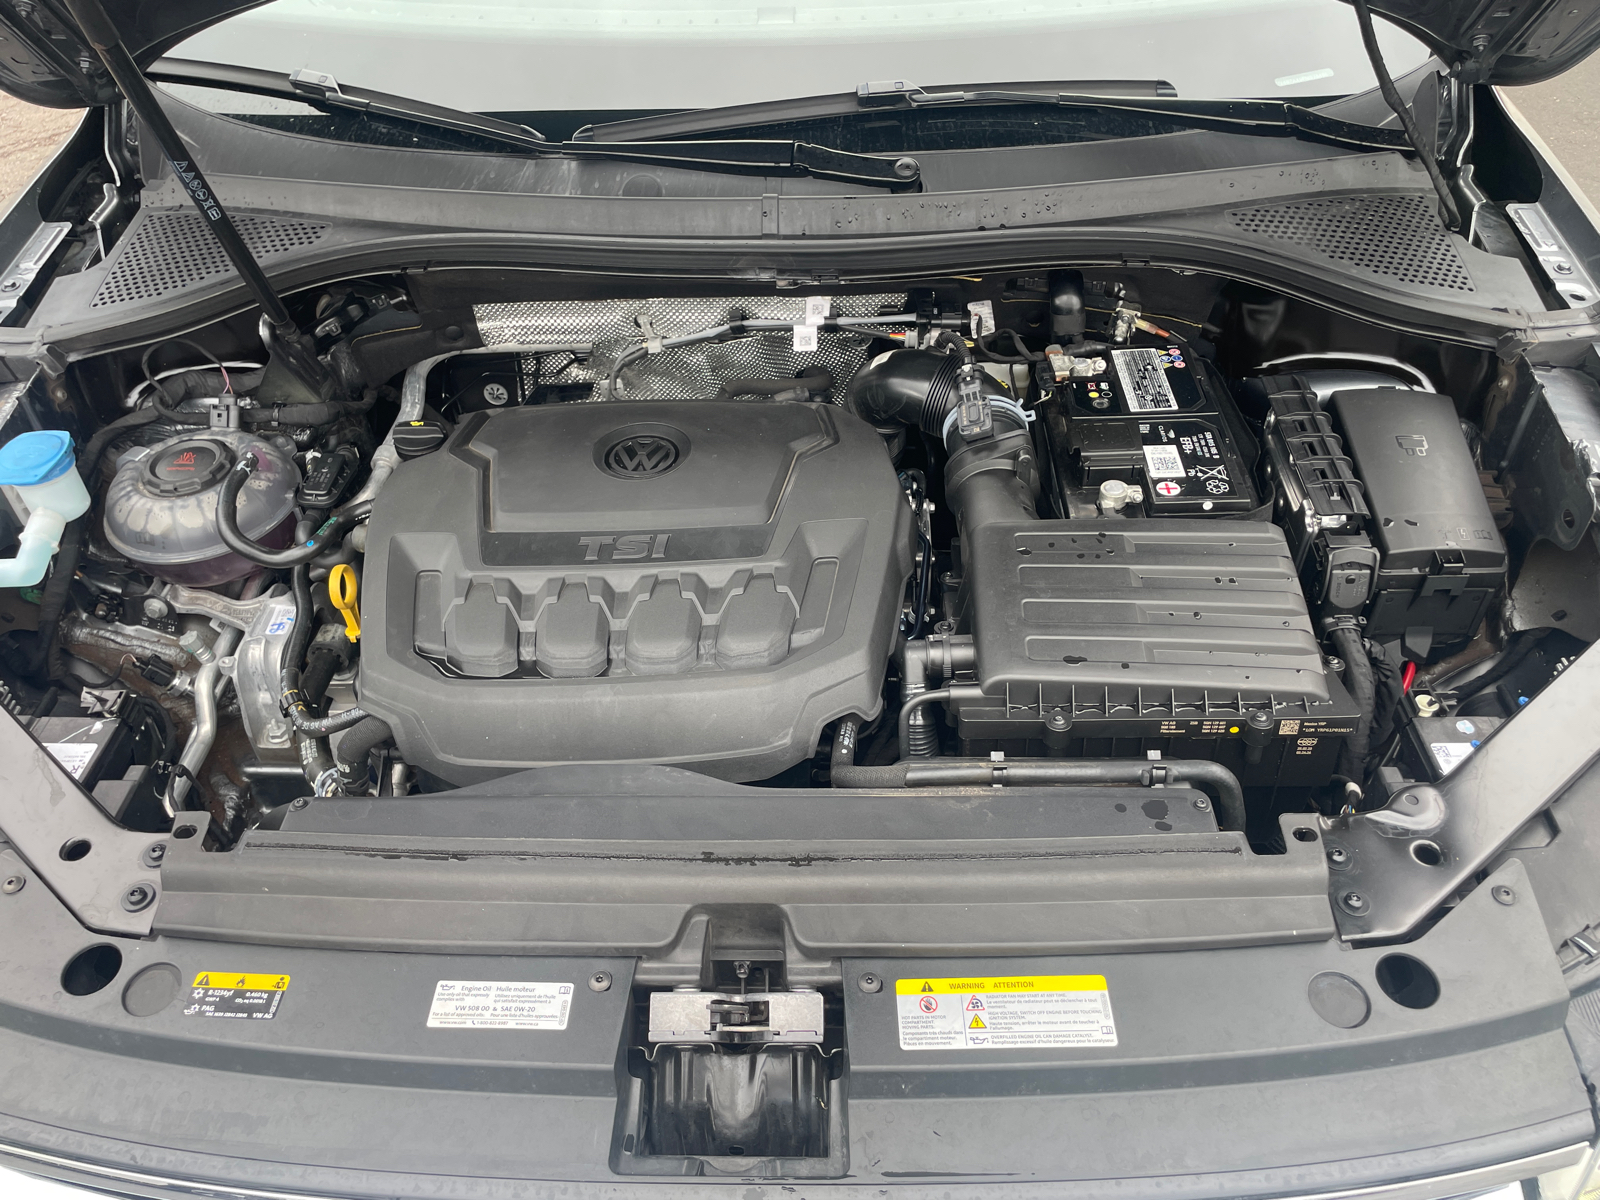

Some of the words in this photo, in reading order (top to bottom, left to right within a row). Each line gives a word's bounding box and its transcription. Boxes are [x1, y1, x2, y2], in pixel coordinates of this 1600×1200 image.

[1180, 438, 1194, 454] EFB+
[578, 534, 671, 561] TSI
[208, 989, 234, 998] R-1234yf
